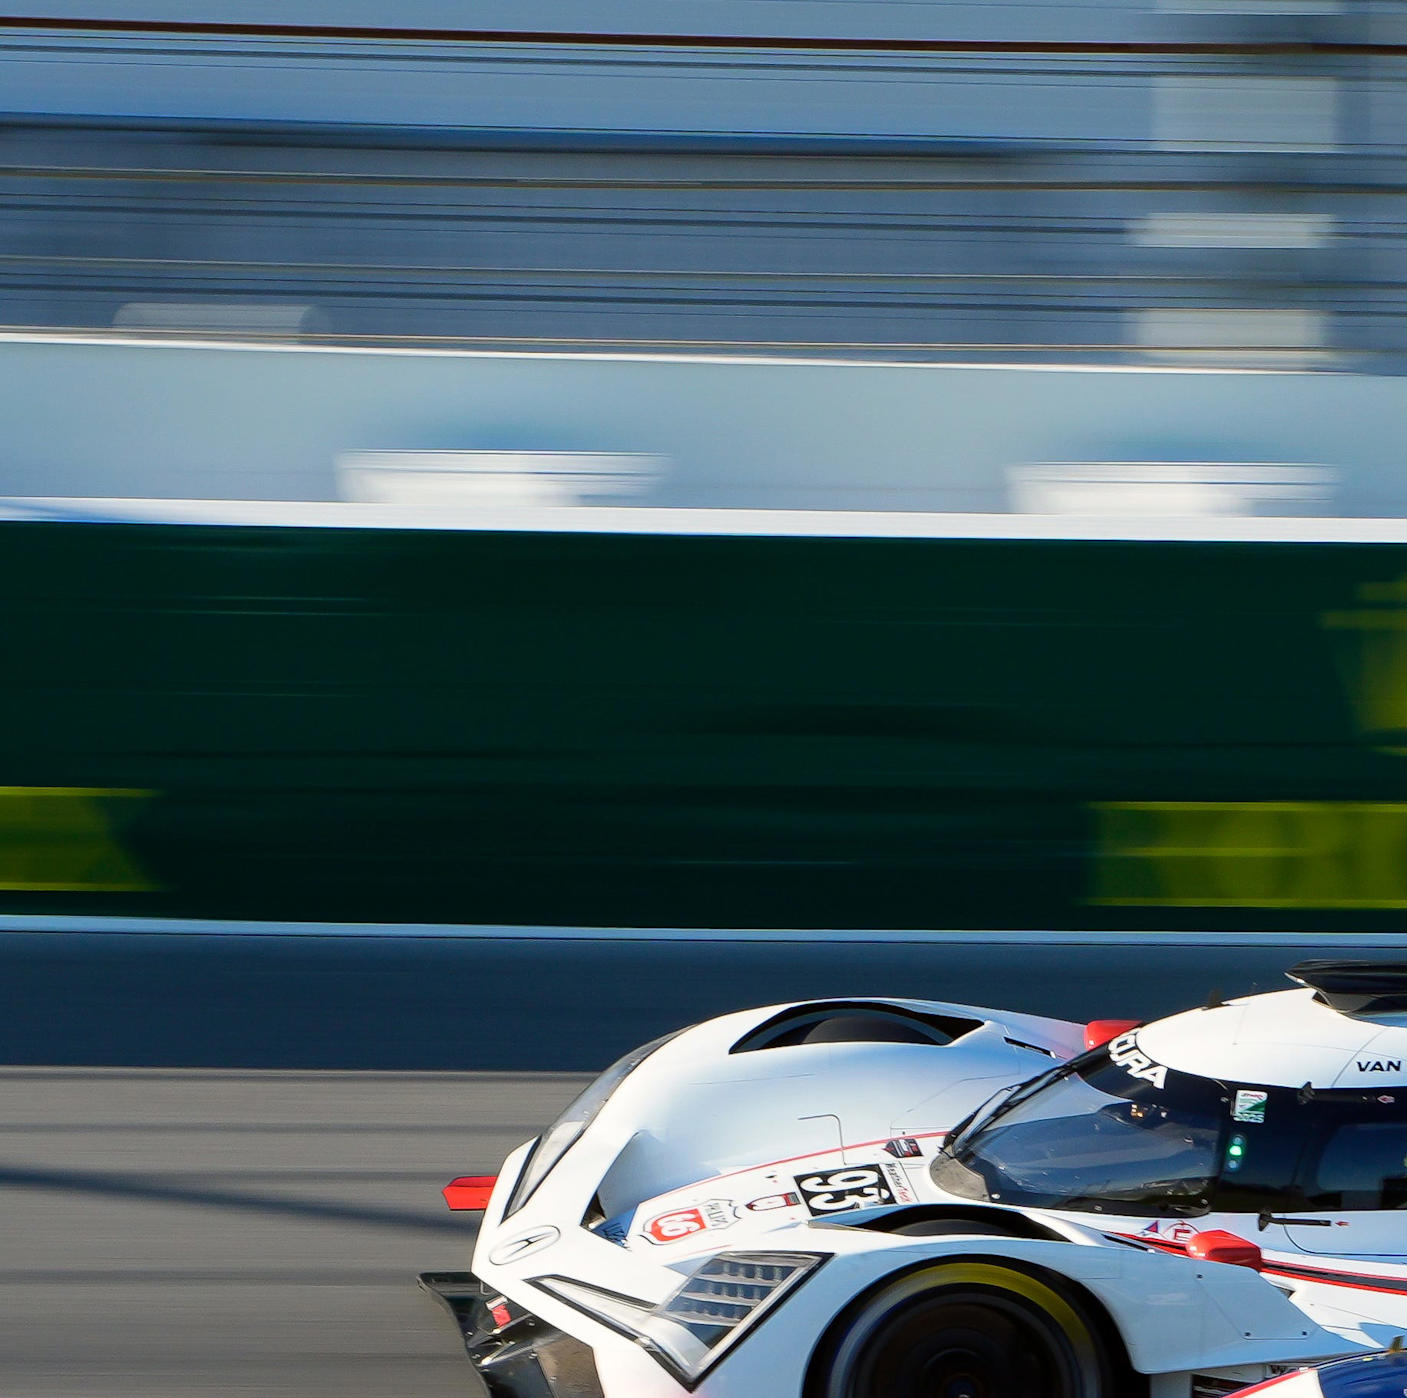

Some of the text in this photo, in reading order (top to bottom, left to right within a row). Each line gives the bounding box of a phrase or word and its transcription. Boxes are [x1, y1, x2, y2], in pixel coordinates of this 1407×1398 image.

[1356, 1060, 1401, 1072] VAN
[800, 1169, 891, 1212] 93
[658, 1213, 702, 1241] 66
